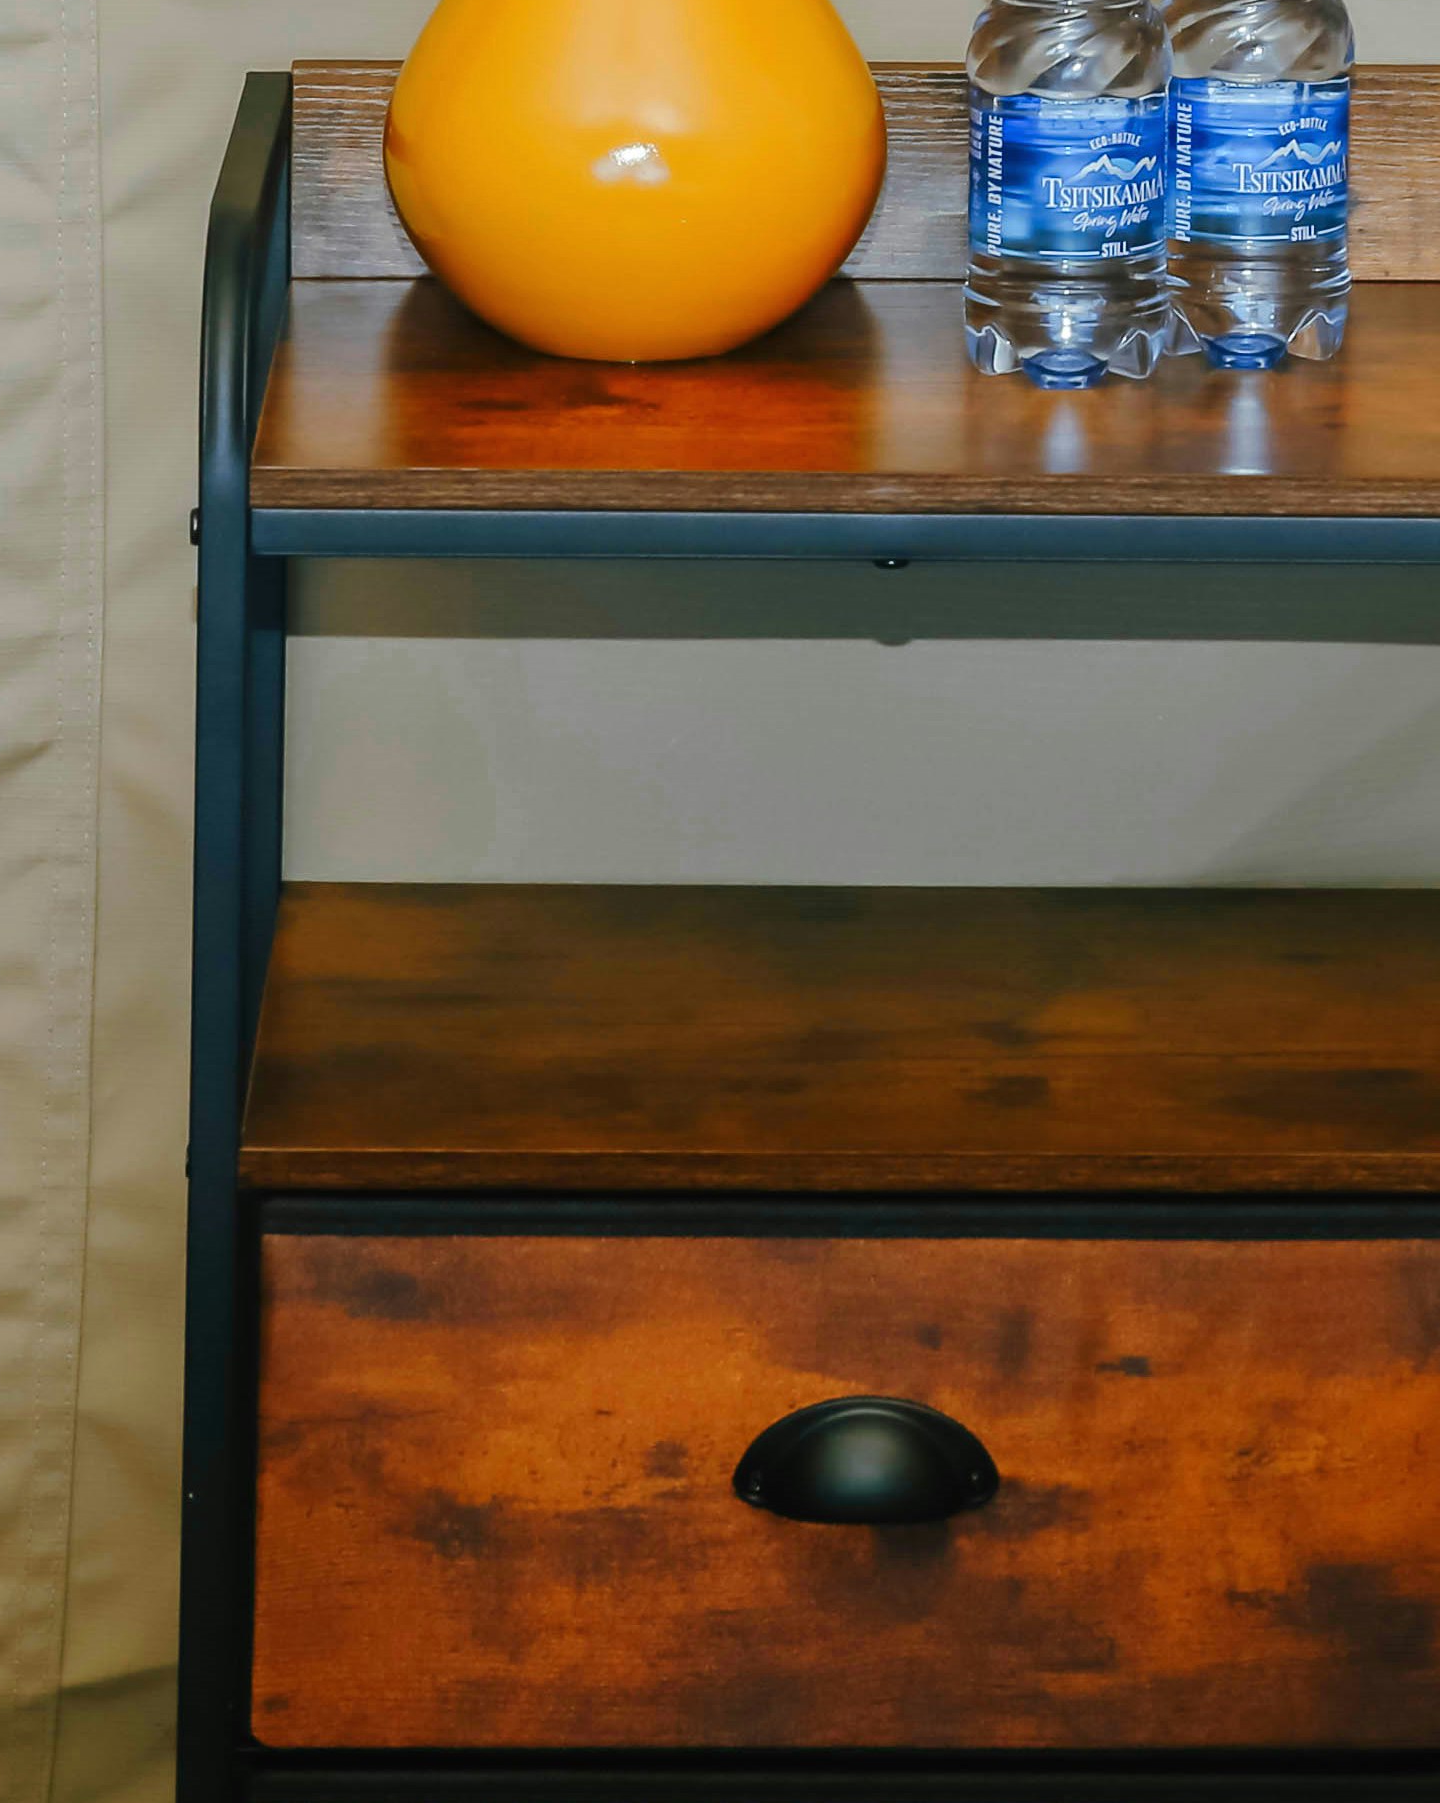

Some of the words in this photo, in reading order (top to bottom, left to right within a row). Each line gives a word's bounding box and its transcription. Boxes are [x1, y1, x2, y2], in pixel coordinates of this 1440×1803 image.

[1176, 102, 1193, 167] NATURE
[1279, 117, 1328, 136] ECO-BOTTLE
[988, 115, 1003, 180] NATURE
[1089, 132, 1141, 150] ECO-BOTTLE
[1175, 169, 1192, 191] BY
[987, 181, 1003, 205] BY
[1175, 195, 1193, 242] PURE,
[1263, 196, 1306, 222] Spring
[987, 209, 1003, 256] PURE,
[1072, 211, 1118, 238] Spring
[1291, 224, 1317, 241] STILL
[1101, 241, 1129, 257] STILL
